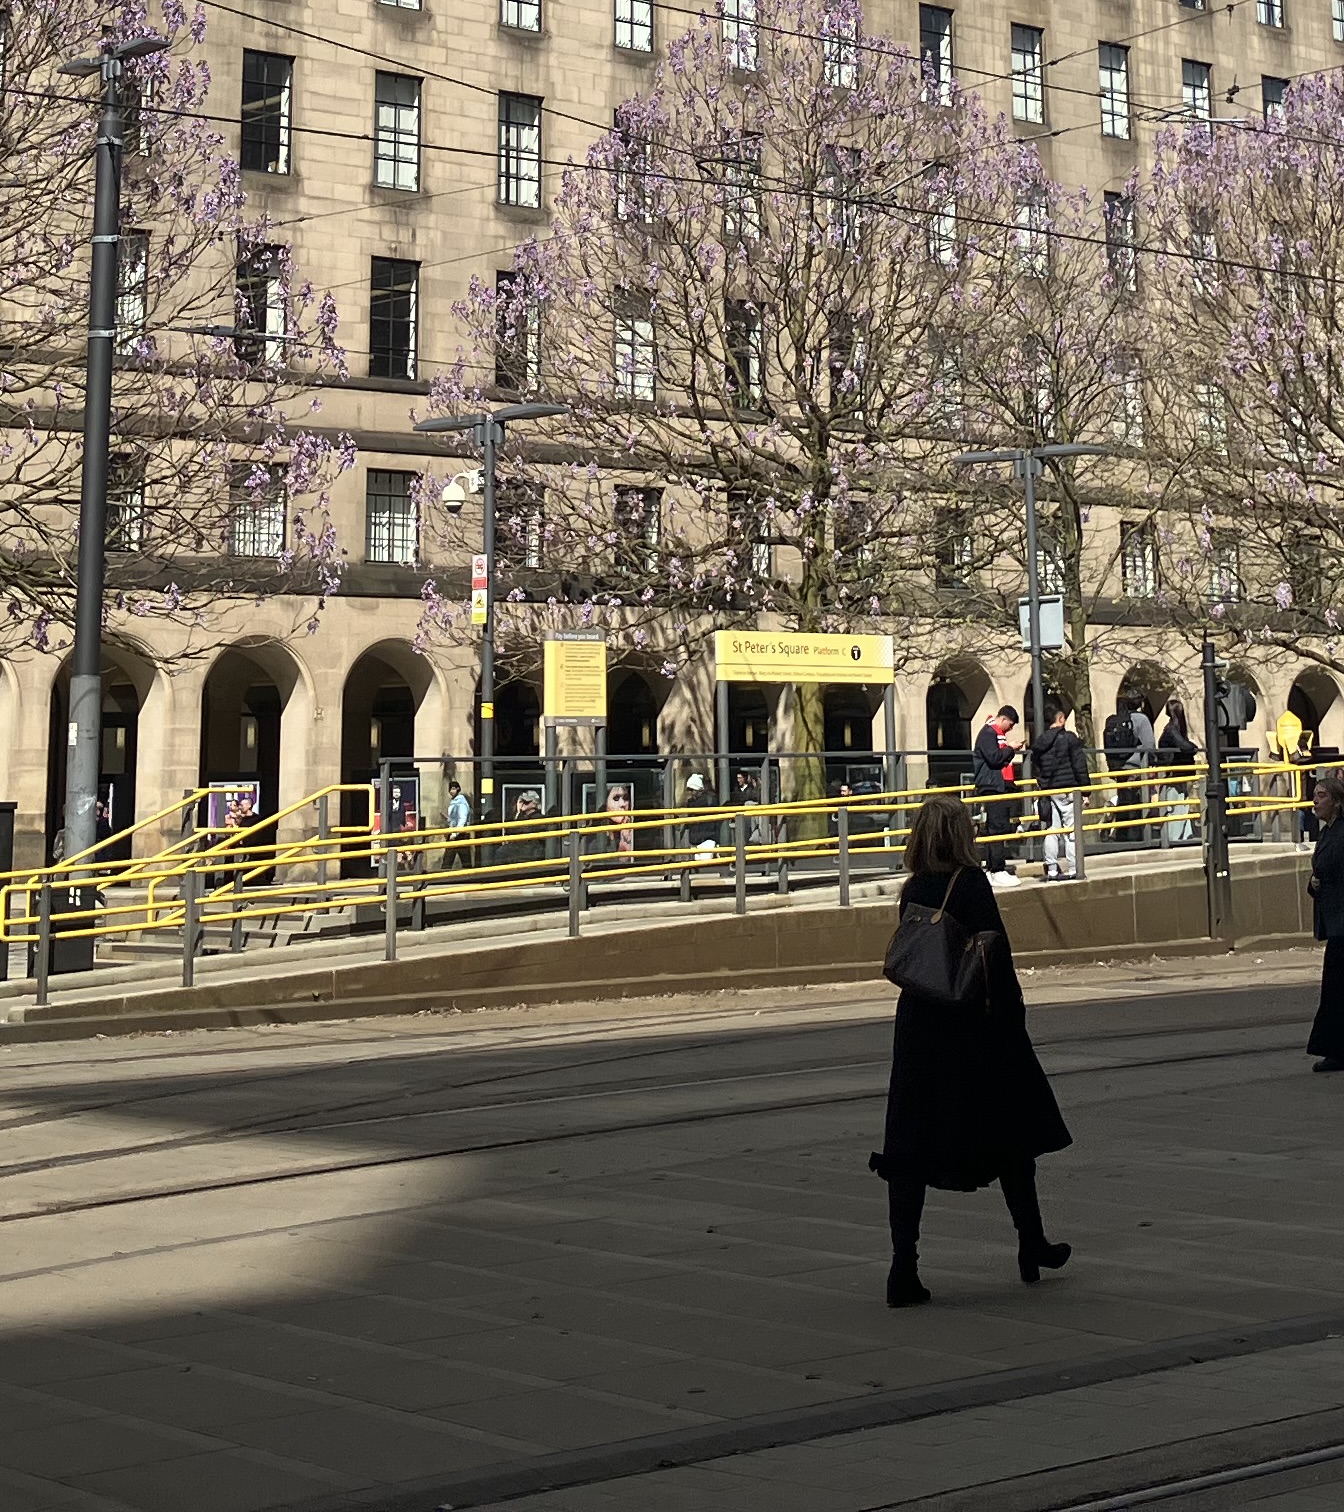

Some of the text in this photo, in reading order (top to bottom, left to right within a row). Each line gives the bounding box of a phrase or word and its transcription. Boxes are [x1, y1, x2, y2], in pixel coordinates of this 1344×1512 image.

[732, 640, 743, 654] St
[744, 640, 776, 654] Peter's
[778, 641, 810, 658] Square
[813, 646, 840, 656] Platform
[853, 650, 859, 659] 1
